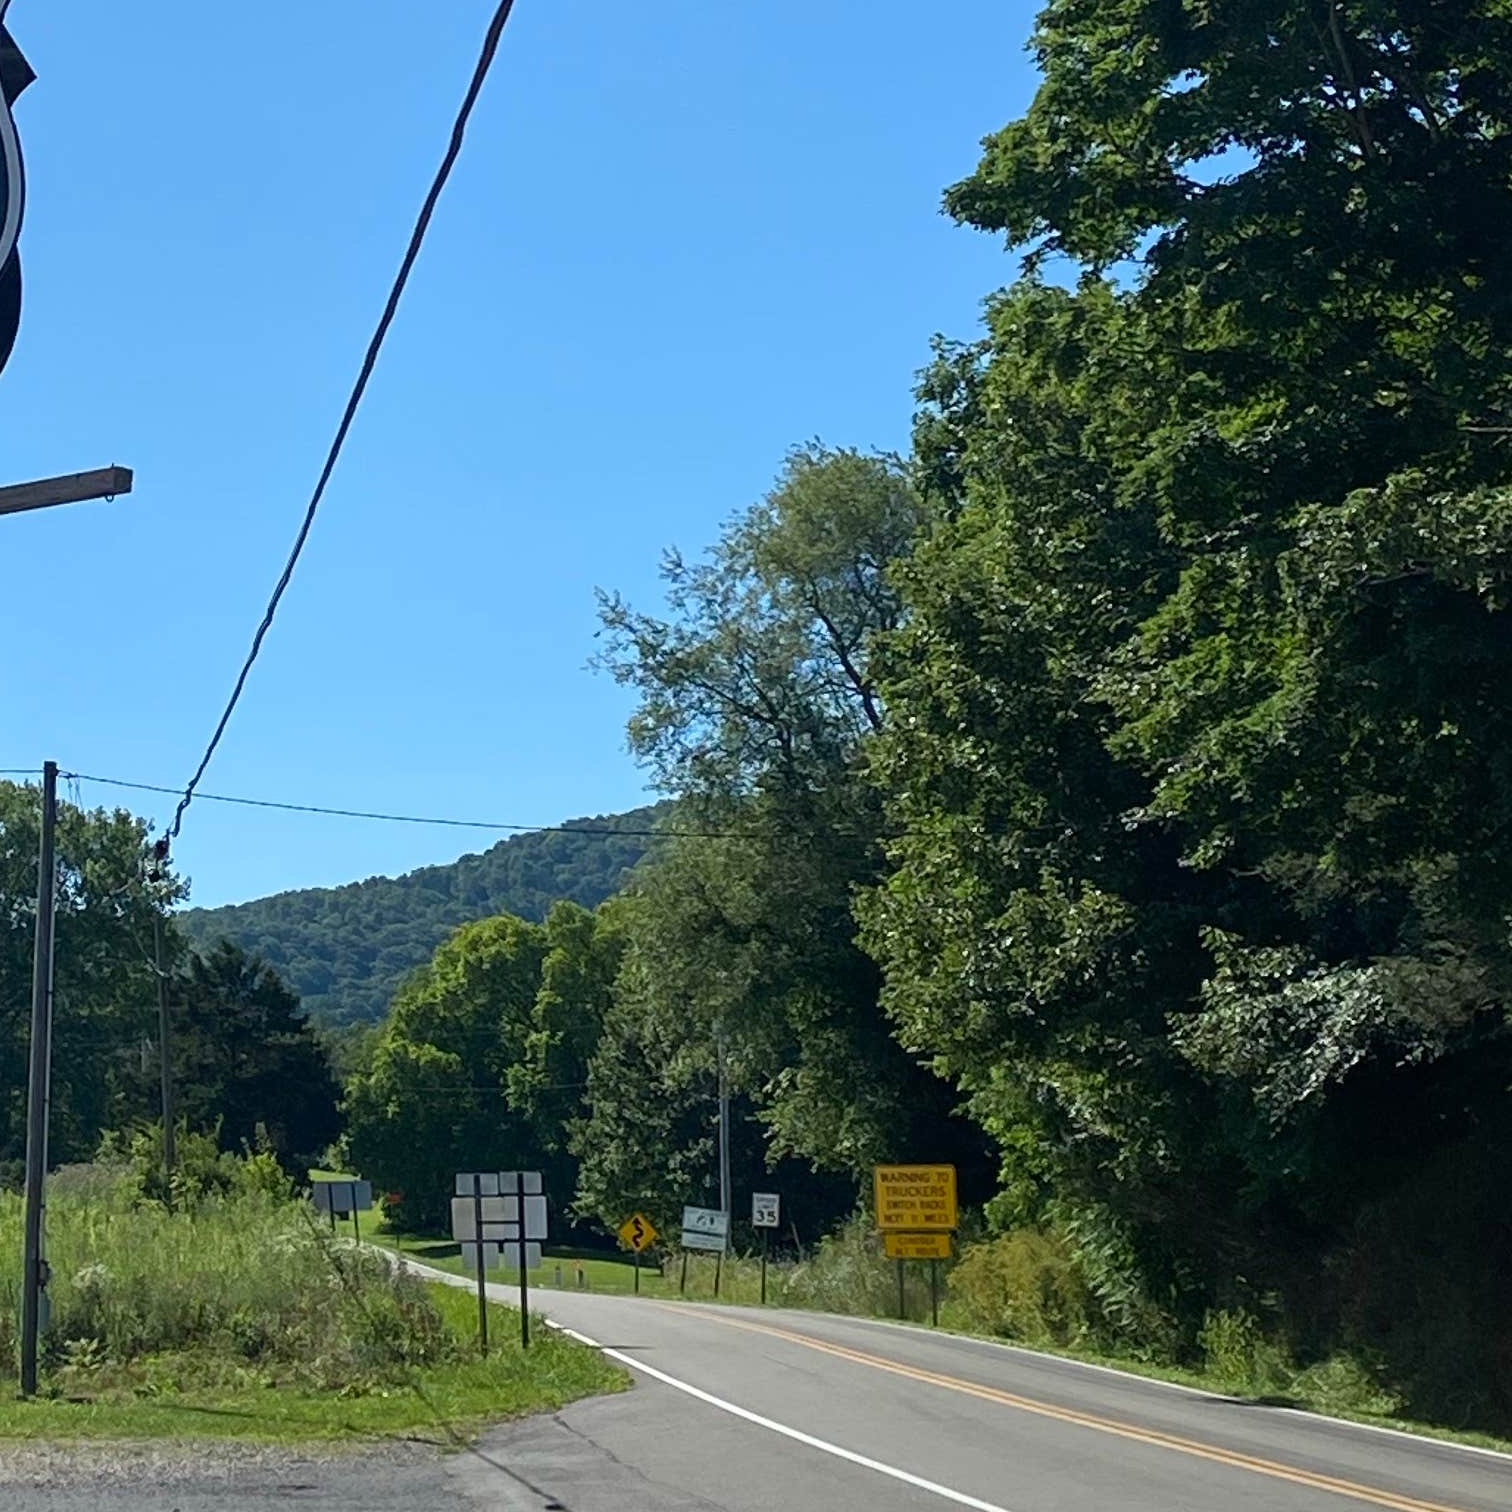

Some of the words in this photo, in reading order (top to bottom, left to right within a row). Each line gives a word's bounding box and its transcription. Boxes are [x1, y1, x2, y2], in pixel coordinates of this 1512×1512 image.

[880, 1172, 931, 1183] WARNING
[936, 1172, 950, 1183] TO
[886, 1186, 946, 1197] TRUCKERS
[756, 1209, 777, 1223] 35
